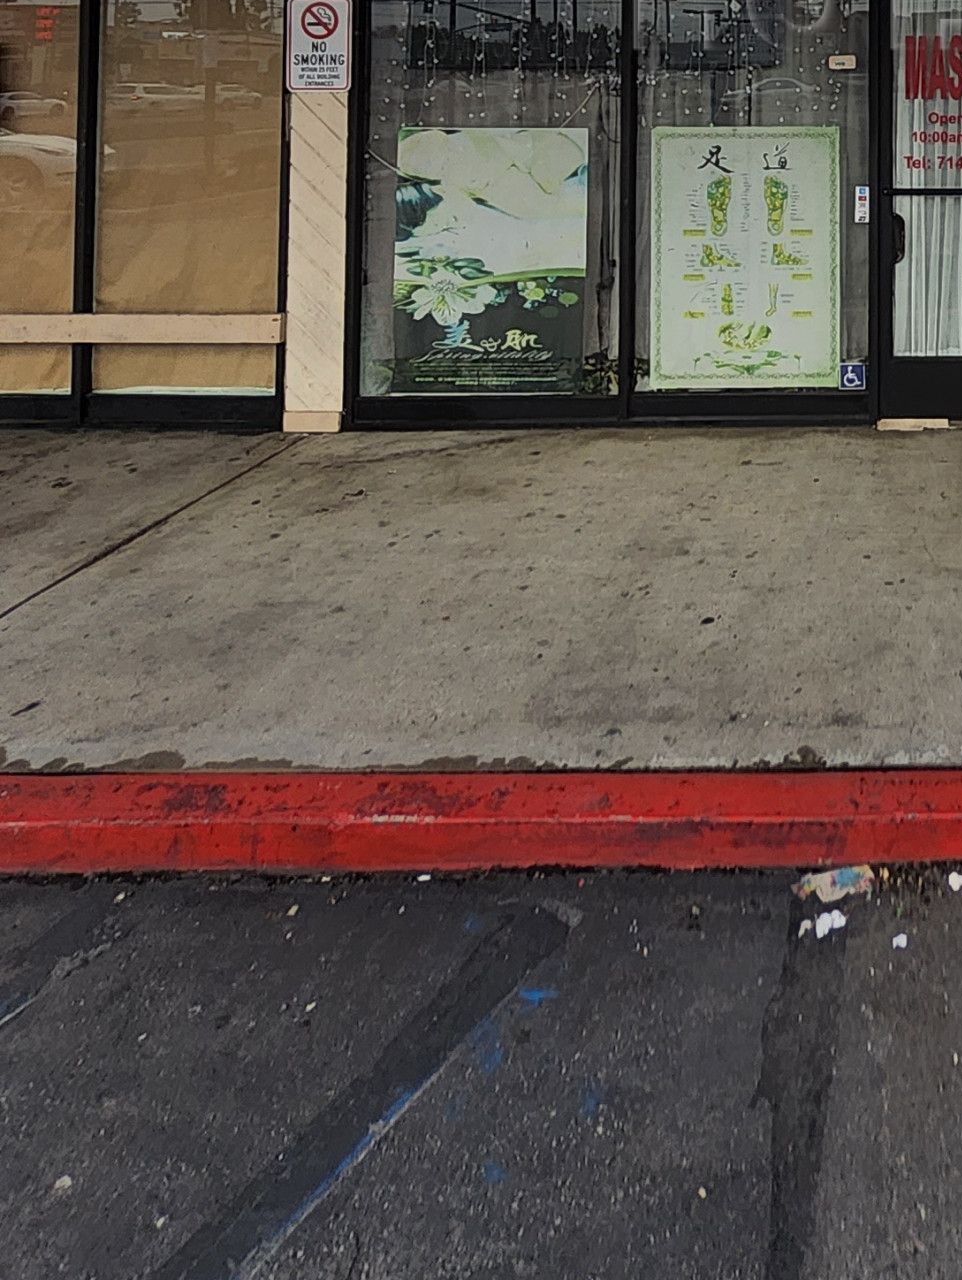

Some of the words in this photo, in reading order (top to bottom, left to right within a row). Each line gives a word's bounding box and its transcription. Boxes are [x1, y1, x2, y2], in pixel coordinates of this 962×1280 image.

[311, 41, 328, 53] NO
[293, 53, 346, 66] SMOKING
[904, 155, 931, 170] Tel:
